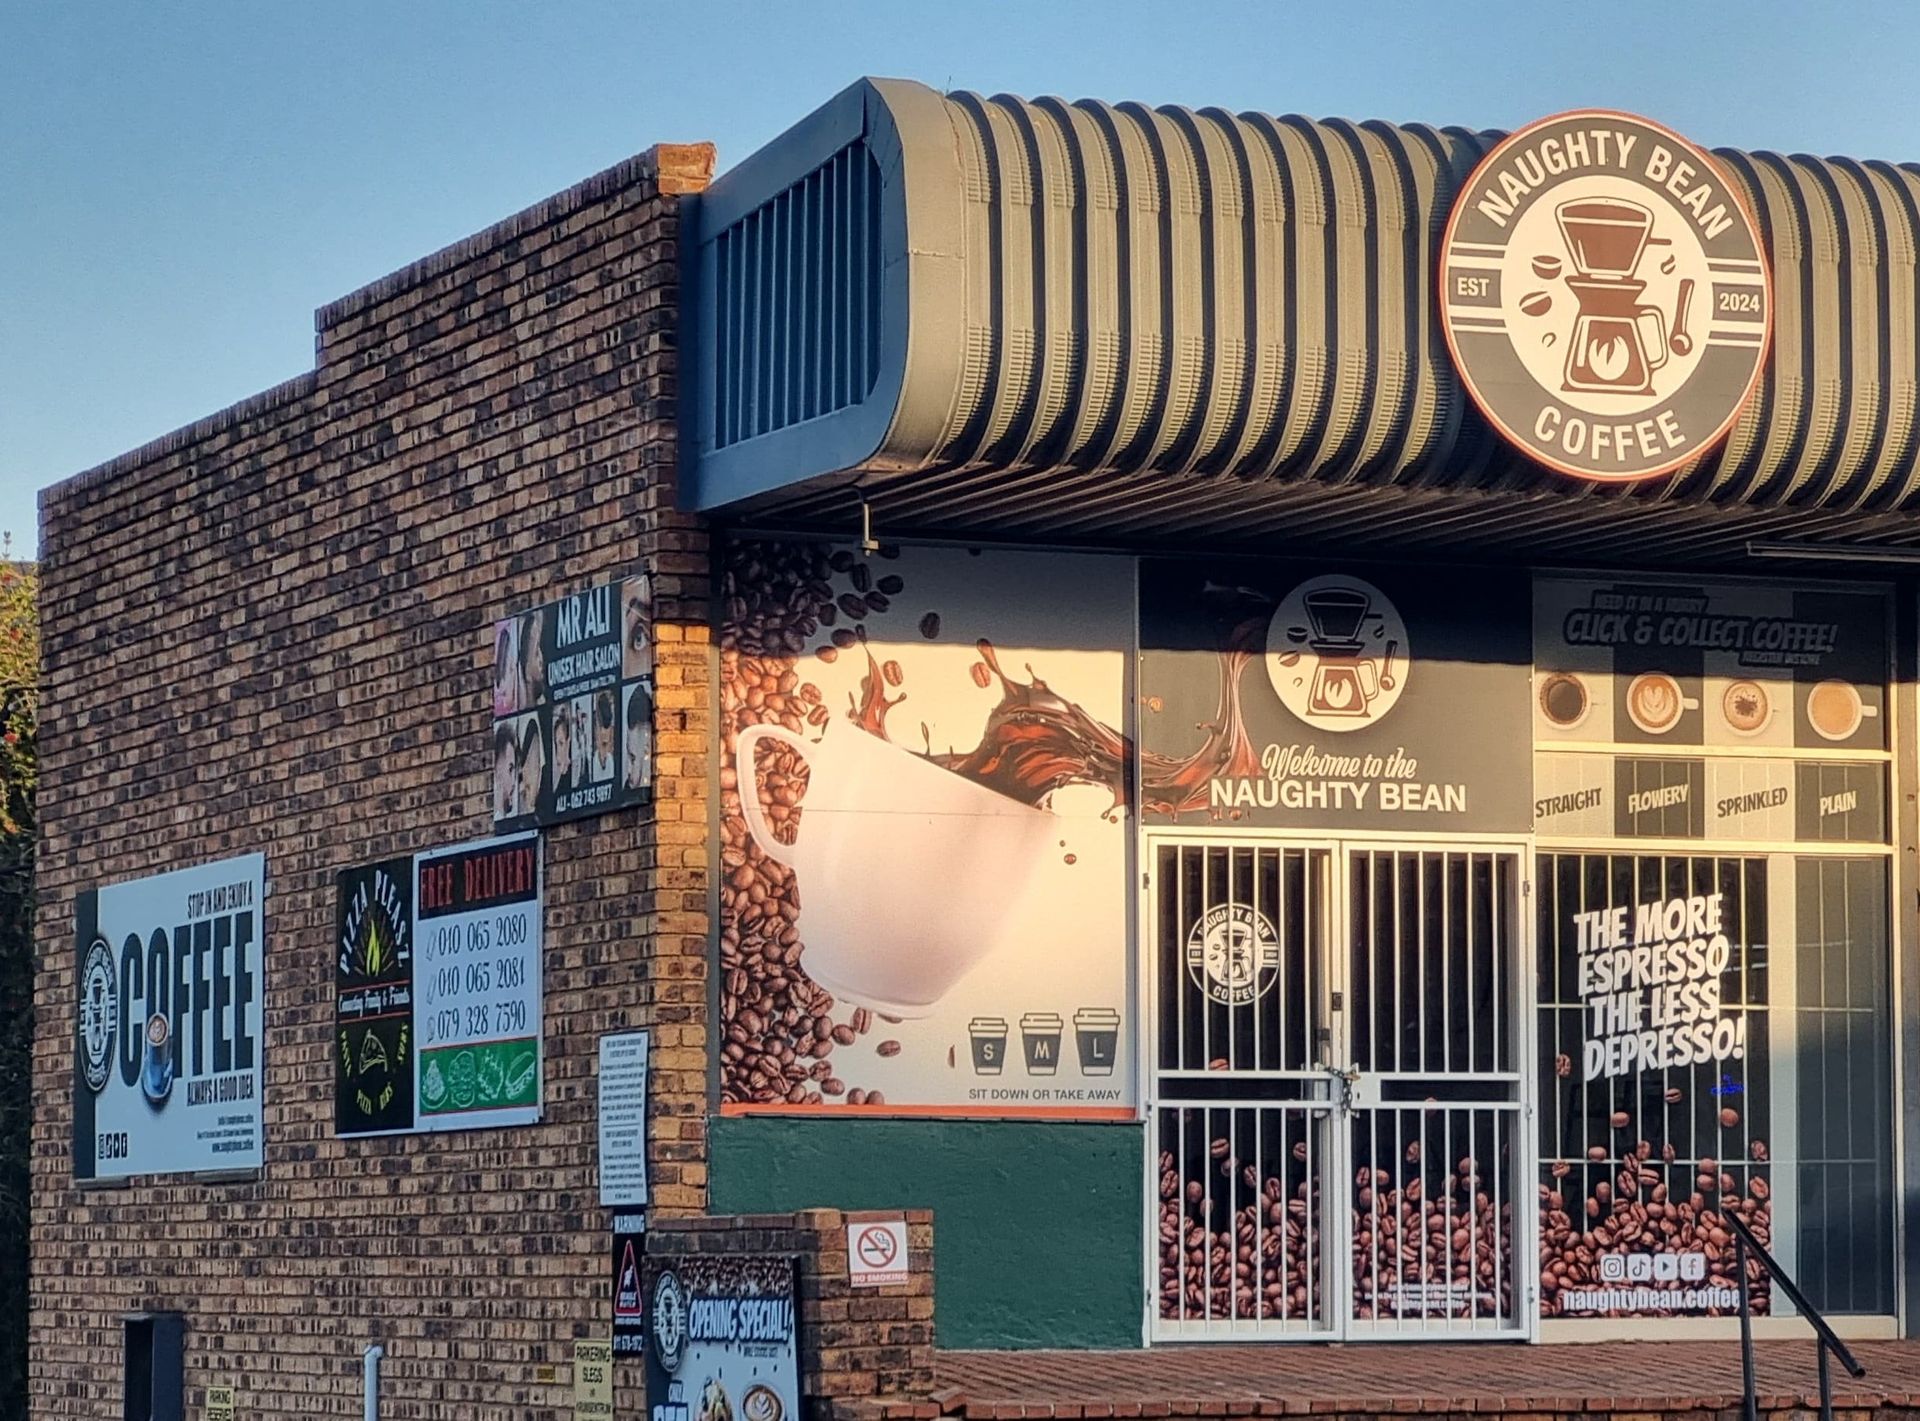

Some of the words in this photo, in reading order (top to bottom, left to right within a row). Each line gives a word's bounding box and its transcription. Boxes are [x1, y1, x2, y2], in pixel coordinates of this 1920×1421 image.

[1476, 129, 1638, 227] NAUGHTY
[1644, 144, 1735, 241] BEAN
[1457, 277, 1489, 297] EST
[1720, 293, 1760, 313] 2024
[1534, 405, 1686, 462] COFFEE
[556, 596, 583, 649] MR
[585, 585, 610, 637] ALI
[1566, 613, 1631, 643] CLICK
[1633, 615, 1654, 644] &
[1659, 617, 1752, 649] COLLECT
[1753, 620, 1838, 653] COFFEE!
[548, 655, 575, 687] UNISEX
[576, 649, 594, 678] HAIR
[595, 642, 620, 672] SALON
[1261, 743, 1359, 782] Welcome
[1361, 753, 1383, 778] to
[1384, 746, 1417, 781] the
[1211, 778, 1369, 811] NAUGHTY
[1379, 782, 1467, 813] BEAN
[1535, 787, 1602, 819] STRAIGHT
[1627, 784, 1689, 814] FLOWERY
[1717, 787, 1789, 819] SPRINKLED
[1819, 790, 1857, 817] PLAIN
[421, 864, 454, 910] FREE
[464, 847, 534, 902] DELIVERY
[187, 891, 204, 919] STOP
[1574, 906, 1628, 954] THE
[1634, 893, 1723, 945] MORE
[339, 881, 368, 975] PIZZA
[439, 924, 461, 956] 010
[467, 920, 490, 952] 065
[496, 913, 526, 947] 2080
[438, 965, 460, 997] 010
[466, 962, 490, 993] 065
[497, 956, 525, 989] 2081
[1578, 934, 1729, 997] ESPRESSO
[119, 911, 254, 1087] COFFEE
[1590, 991, 1643, 1038] THE
[1651, 978, 1721, 1028] LESS
[437, 1007, 460, 1040] 079
[466, 1004, 489, 1037] 328
[496, 999, 526, 1033] 7590
[983, 1043, 993, 1060] S
[1034, 1041, 1049, 1060] M
[1093, 1037, 1104, 1058] L
[1584, 1016, 1747, 1082] DEPRESSO!
[969, 1088, 988, 1100] SIT
[991, 1089, 1029, 1100] DOWN
[1032, 1089, 1050, 1100] OR
[1053, 1089, 1084, 1100] TAKE
[1087, 1089, 1121, 1101] AWAY
[852, 1274, 865, 1283] NO
[867, 1272, 908, 1282] SMOKING
[1563, 1287, 1740, 1312] naughtybean.coffee
[689, 1299, 737, 1340] OPENING
[738, 1299, 789, 1341] SPECIAL!
